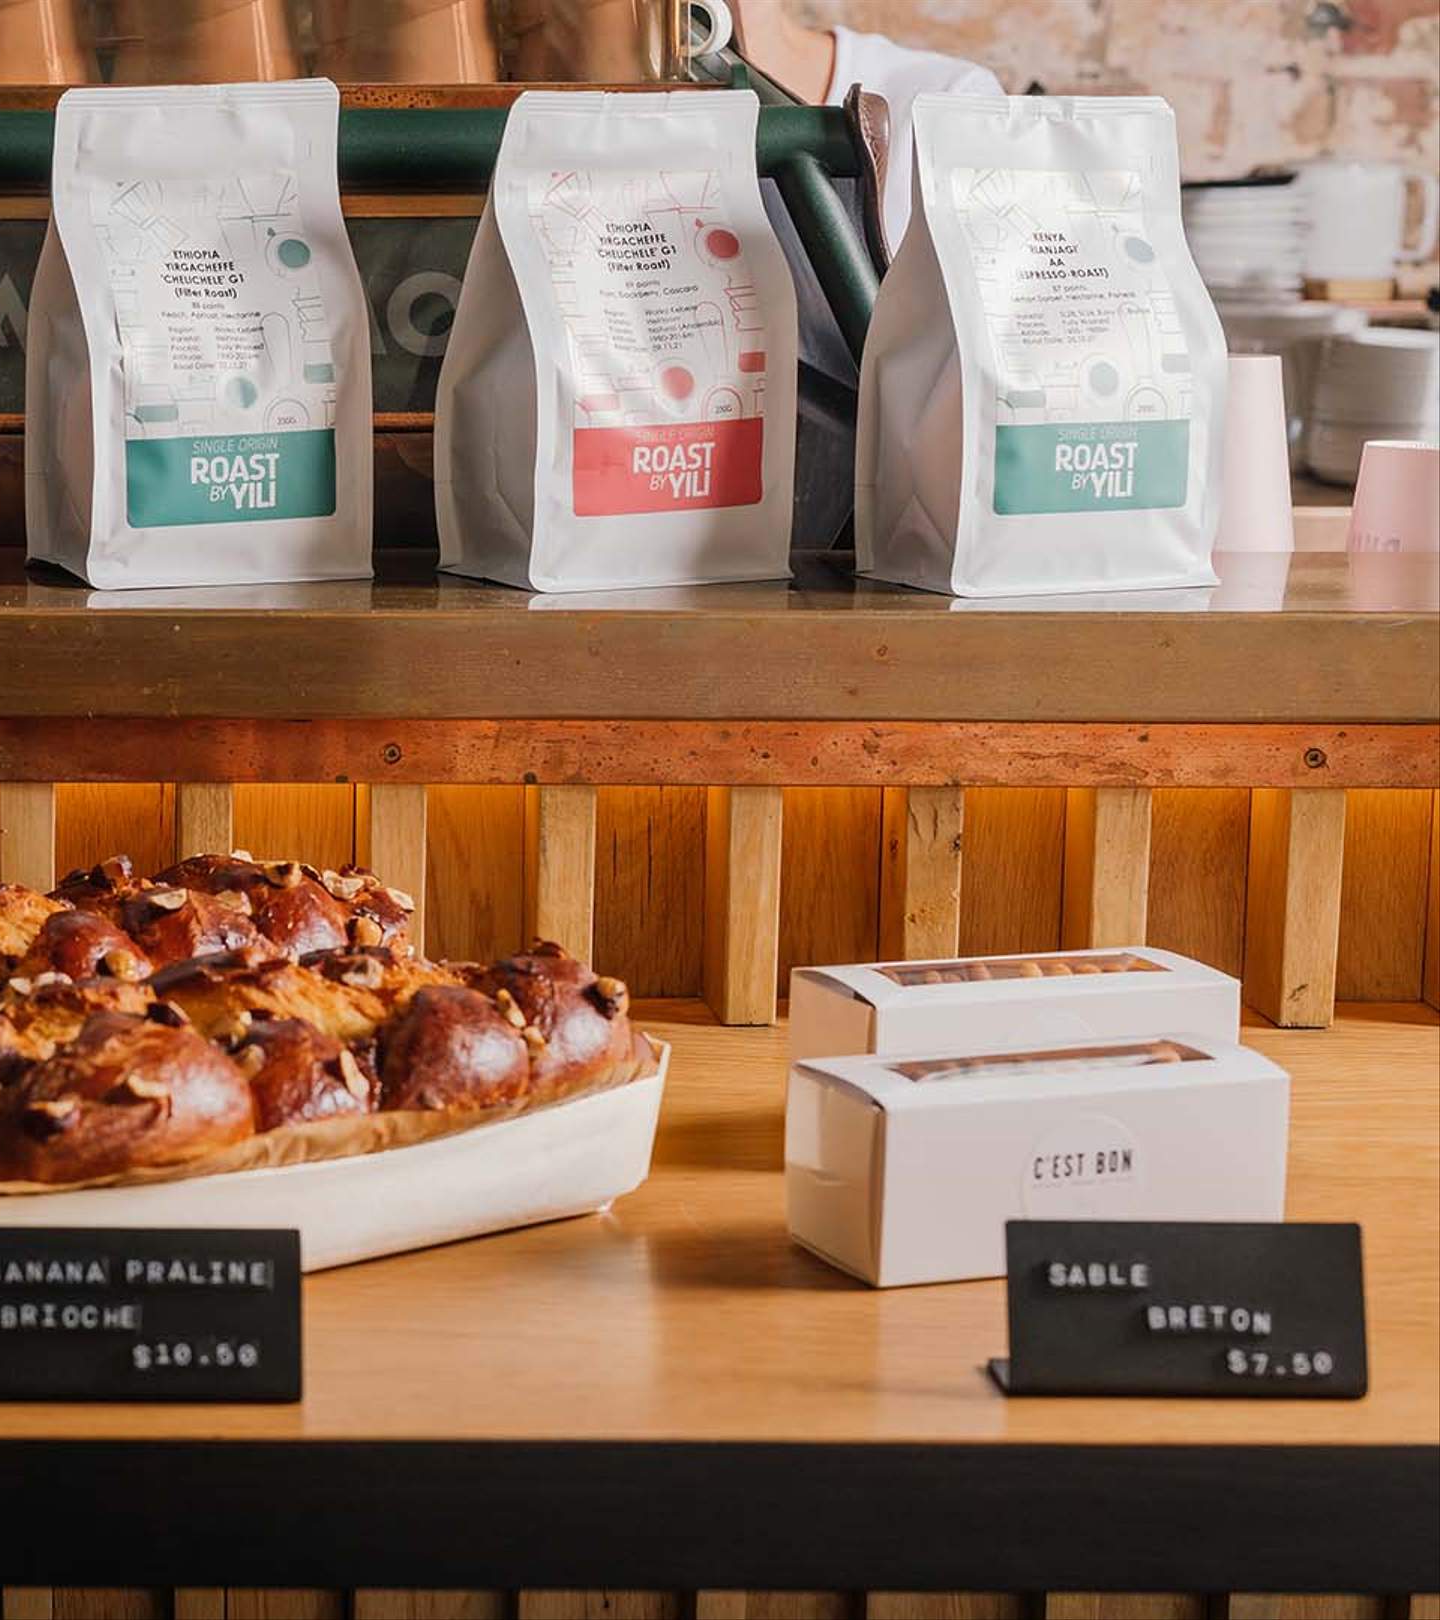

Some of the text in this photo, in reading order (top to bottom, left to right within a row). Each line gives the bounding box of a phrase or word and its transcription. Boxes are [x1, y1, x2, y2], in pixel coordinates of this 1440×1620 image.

[605, 222, 652, 233] ETHIOPIA
[1032, 232, 1067, 242] KENYA
[172, 249, 221, 260] ETHIOPIA
[660, 244, 677, 256] G1
[1049, 258, 1066, 267] AA
[164, 261, 235, 273] YIRGACHEFFE
[635, 258, 671, 271] Roast)
[203, 287, 238, 300] Roast)
[192, 436, 279, 454] SINGLE ORIGIN
[632, 441, 716, 474] ROAST
[1056, 442, 1139, 472] ROAST
[191, 453, 280, 484] ROAST
[209, 480, 277, 509] BY YILI
[649, 470, 712, 499] BY YILI
[1071, 470, 1134, 499] BY YILI
[1033, 1148, 1132, 1180] C'EST BON
[124, 1259, 267, 1286] PRALINE
[1048, 1262, 1150, 1287] SABLE
[0, 1304, 136, 1330] BRIOCHE
[1147, 1304, 1272, 1335] BRETON
[131, 1342, 258, 1369] $10.50
[1227, 1349, 1333, 1375] $7.50
